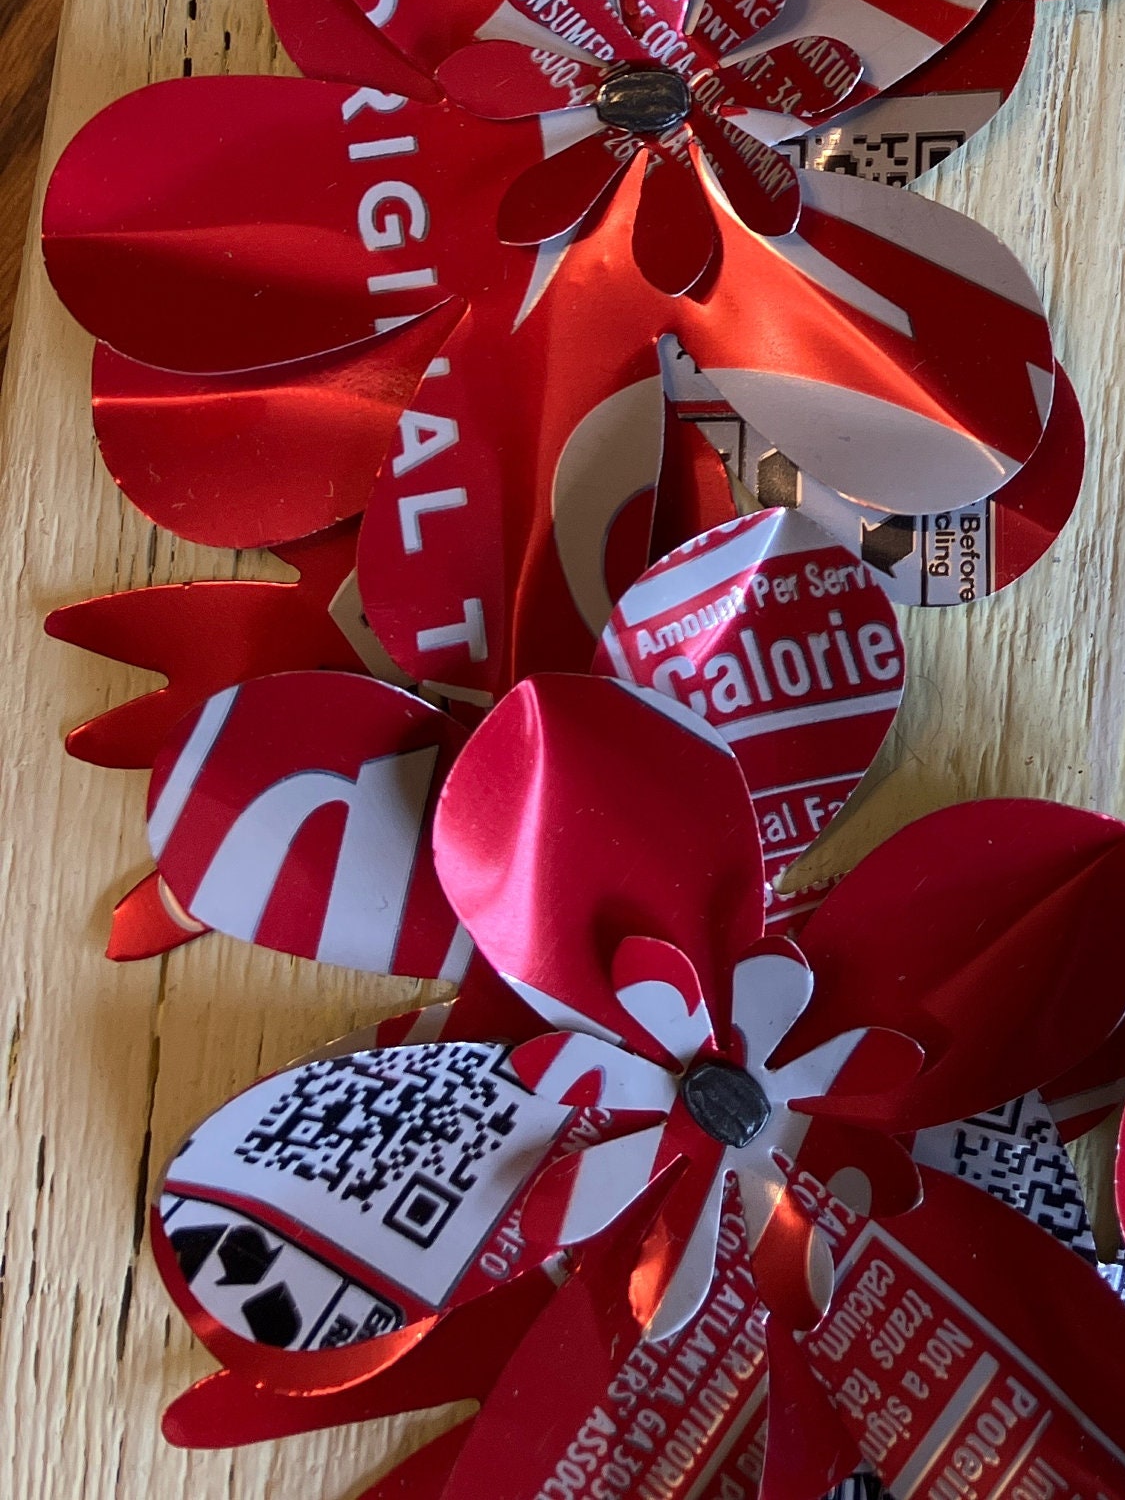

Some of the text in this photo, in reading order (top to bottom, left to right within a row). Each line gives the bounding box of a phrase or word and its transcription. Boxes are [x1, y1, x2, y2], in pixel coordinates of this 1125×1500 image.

[636, 585, 747, 661] Amount
[750, 572, 801, 609] Per
[869, 1289, 934, 1371] trans
[917, 1318, 974, 1380] Not
[901, 1369, 930, 1399] a
